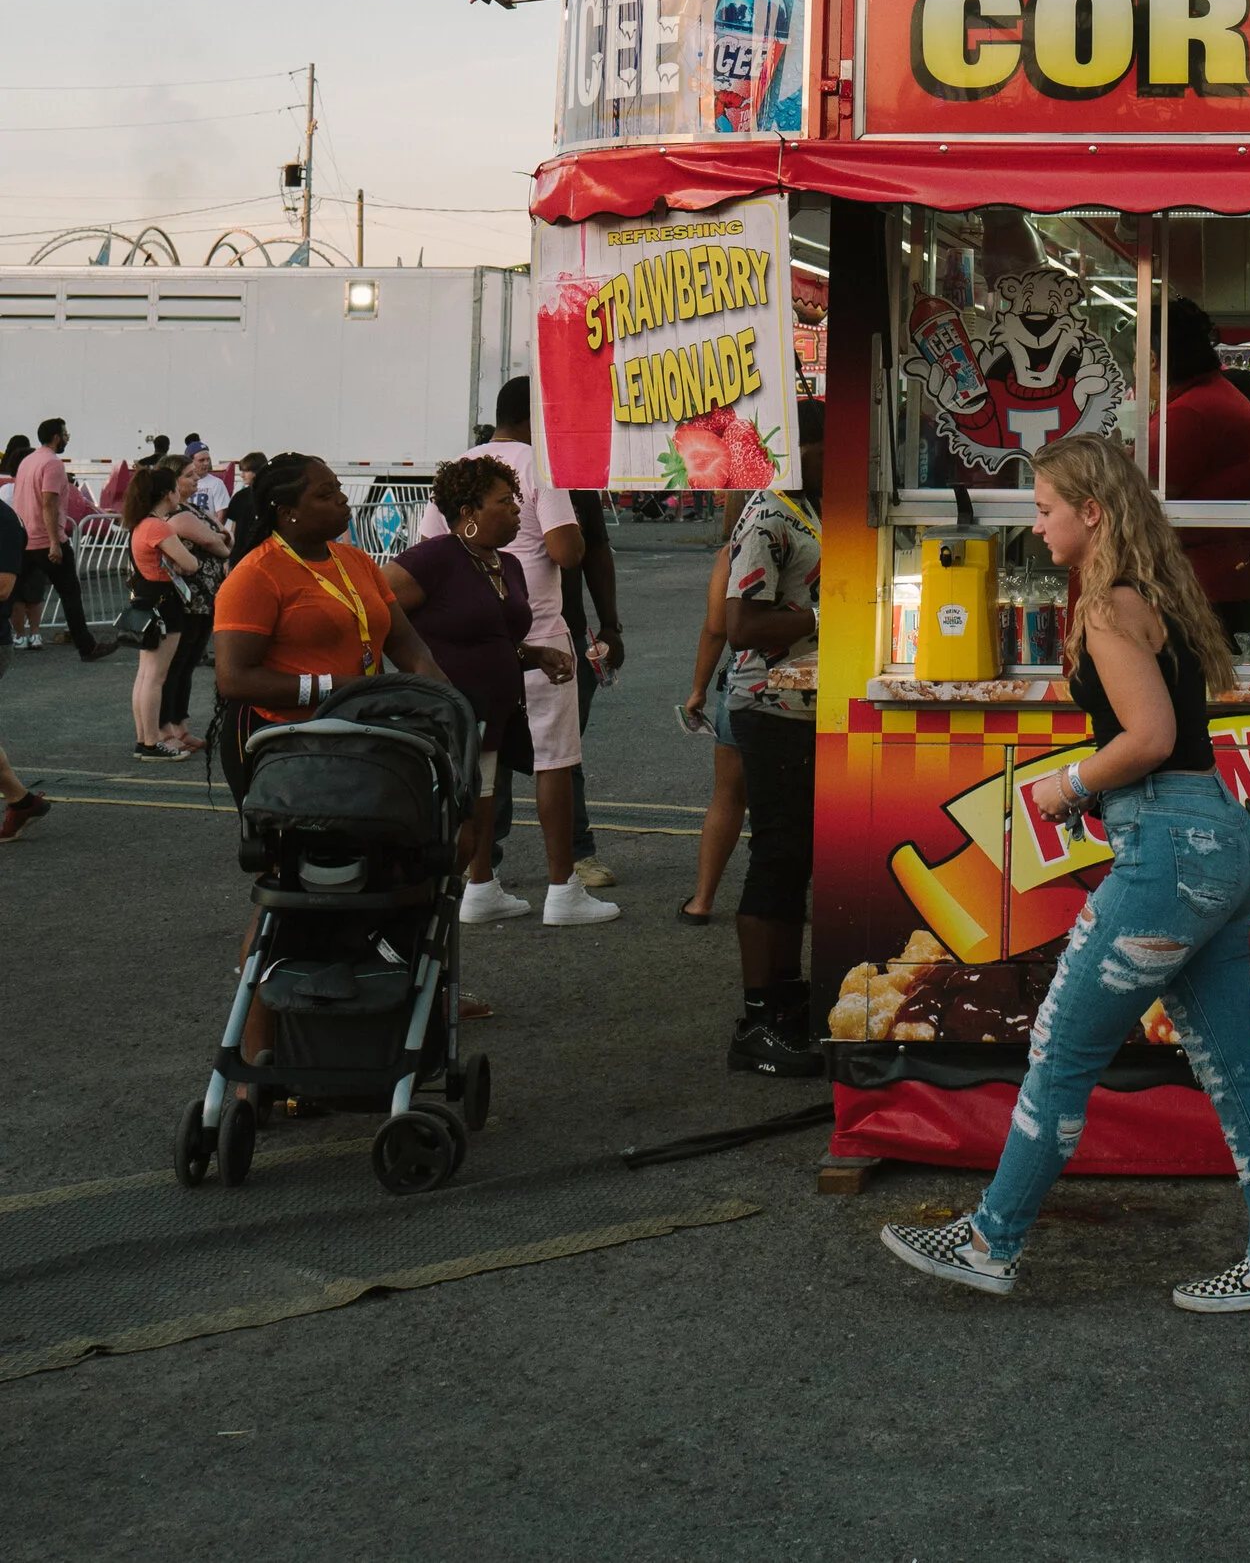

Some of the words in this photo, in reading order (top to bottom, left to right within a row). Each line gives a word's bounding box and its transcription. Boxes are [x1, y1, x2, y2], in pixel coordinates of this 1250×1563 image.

[607, 220, 743, 246] REFRESHING
[585, 244, 770, 351] STRAWBERRY
[926, 325, 964, 359] ICEE
[609, 326, 761, 424] LEMONADE
[758, 1063, 776, 1072] FILA
